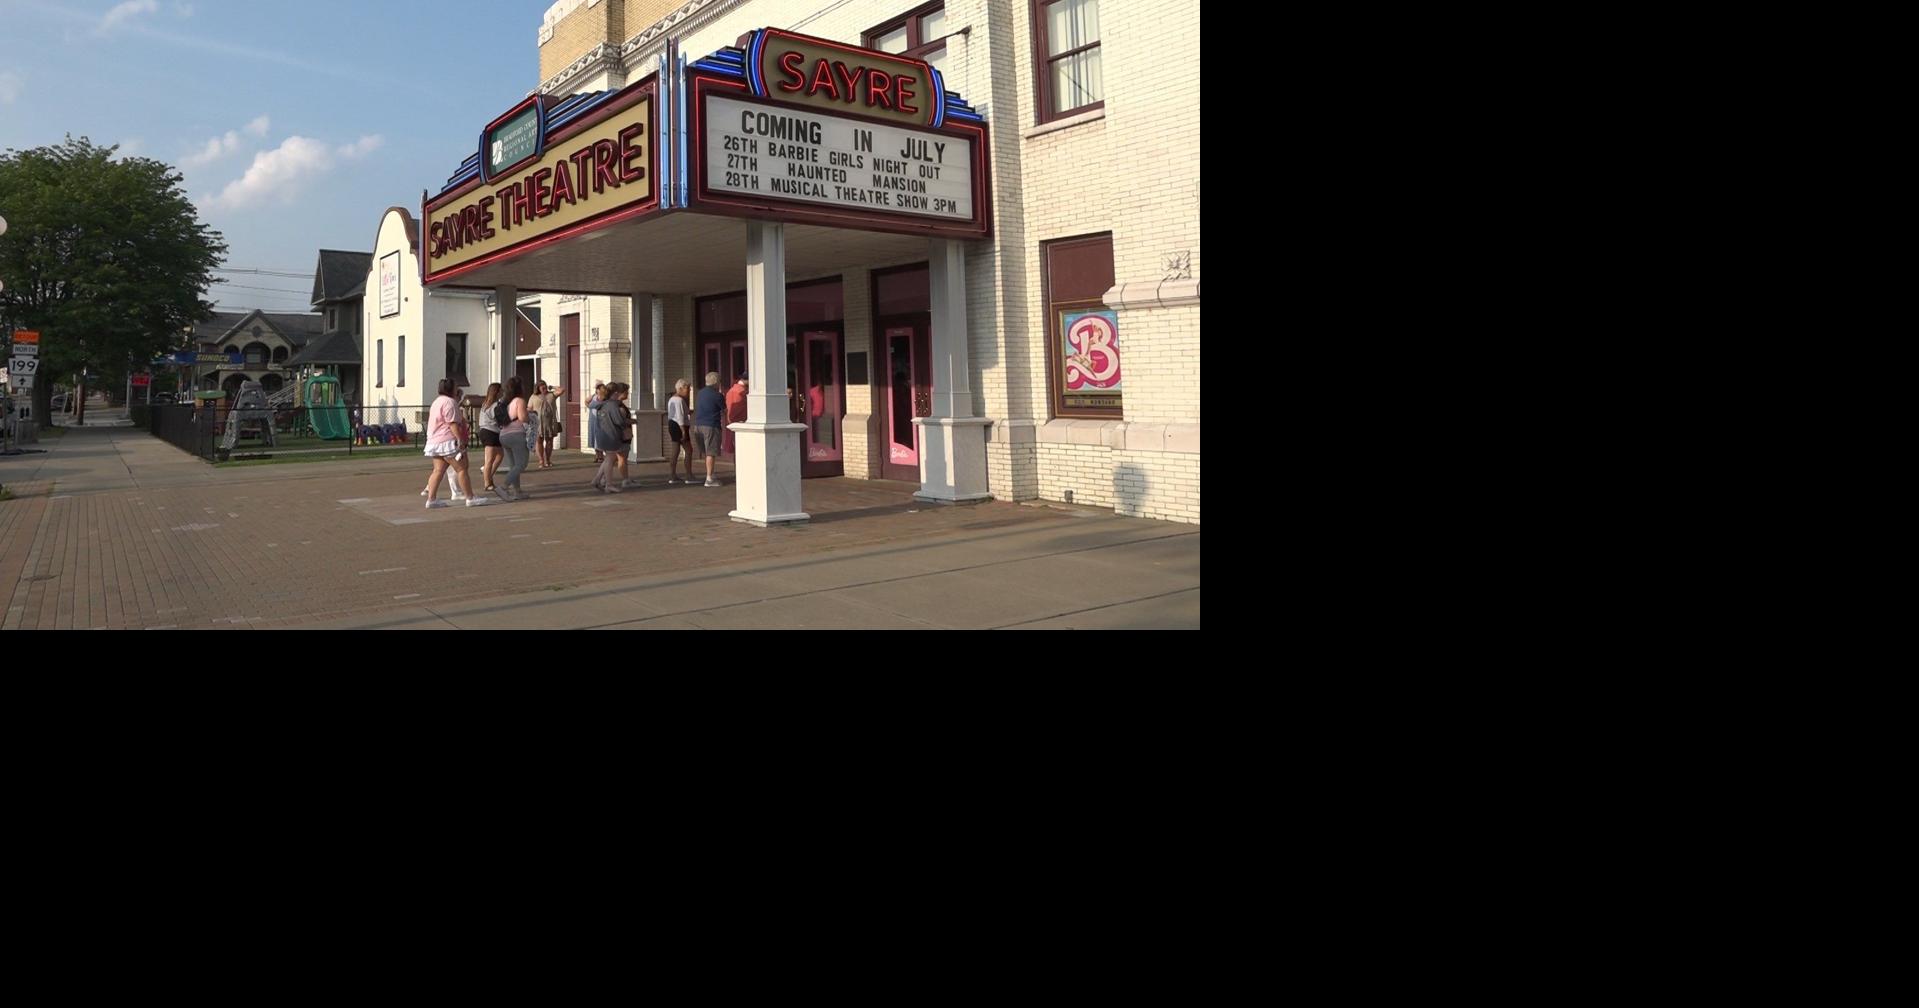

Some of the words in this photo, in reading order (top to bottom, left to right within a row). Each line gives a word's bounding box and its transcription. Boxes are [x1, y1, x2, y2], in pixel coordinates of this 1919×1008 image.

[777, 50, 919, 114] SAYRE
[503, 134, 527, 152] REGIONAL
[724, 134, 758, 154] 26TH
[768, 141, 819, 163] BARBIE
[829, 152, 864, 169] GIRLS
[873, 158, 908, 175] NIGHT
[919, 164, 941, 180] OUT
[741, 110, 822, 145] COMING
[854, 128, 873, 153] IN
[900, 137, 946, 164] JULY
[430, 194, 496, 259] SAYRE
[496, 122, 646, 230] THEATRE
[726, 172, 759, 190] 28TH
[770, 179, 828, 198] MUSICAL
[834, 186, 890, 206] THEATRE
[896, 194, 929, 210] SHOW
[933, 197, 957, 214] 3PM
[727, 153, 758, 172] 27TH
[788, 163, 847, 183] HAUNTED
[872, 174, 927, 194] MANSION
[12, 360, 36, 372] 199
[195, 353, 230, 362] SUNOCO
